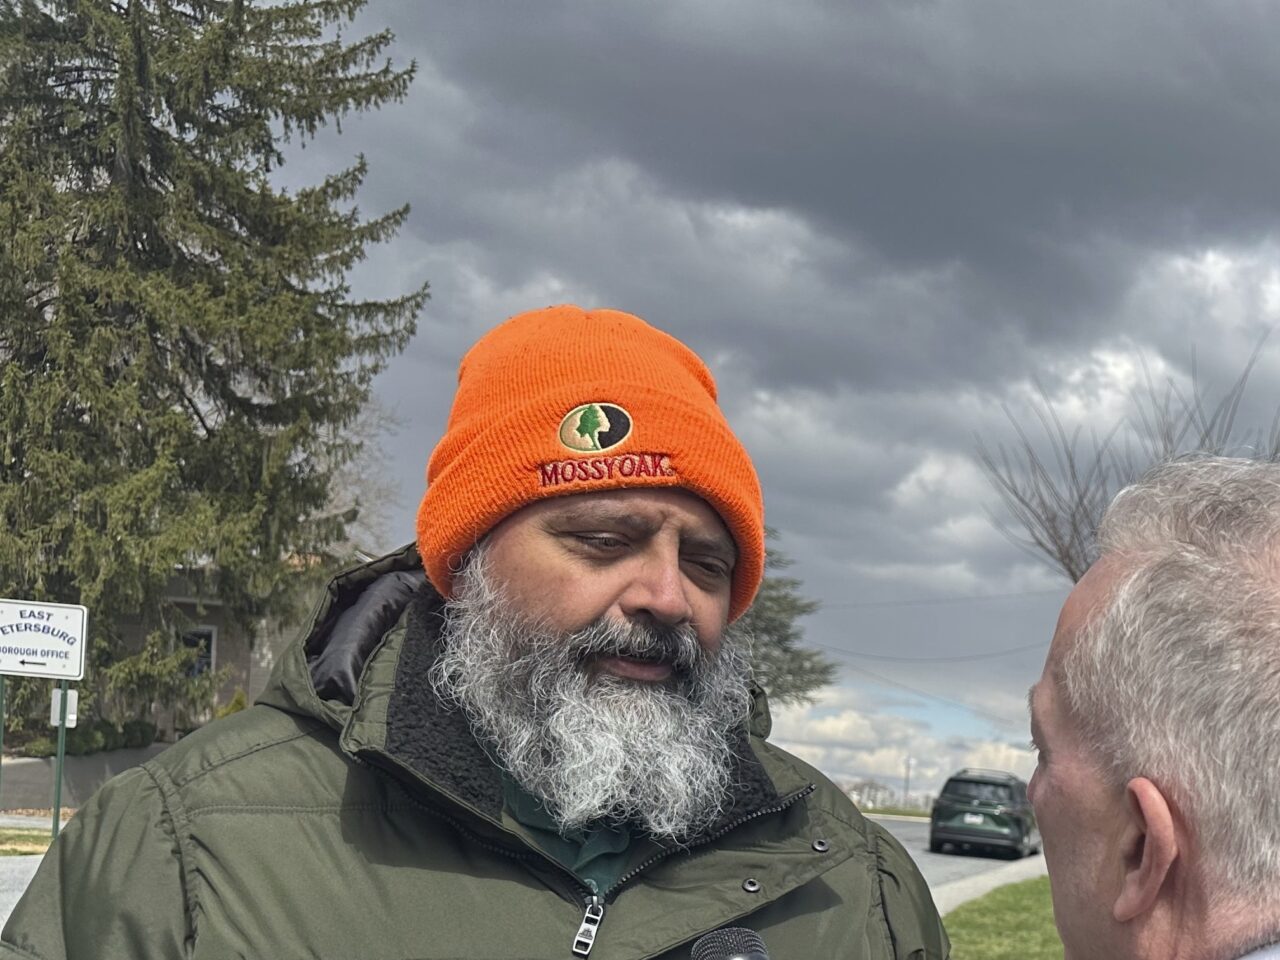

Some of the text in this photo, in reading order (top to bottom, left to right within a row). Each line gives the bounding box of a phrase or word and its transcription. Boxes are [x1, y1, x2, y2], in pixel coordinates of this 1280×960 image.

[19, 609, 54, 622] EAST
[0, 622, 77, 646] ETERSBURG
[40, 649, 70, 660] OFFICE
